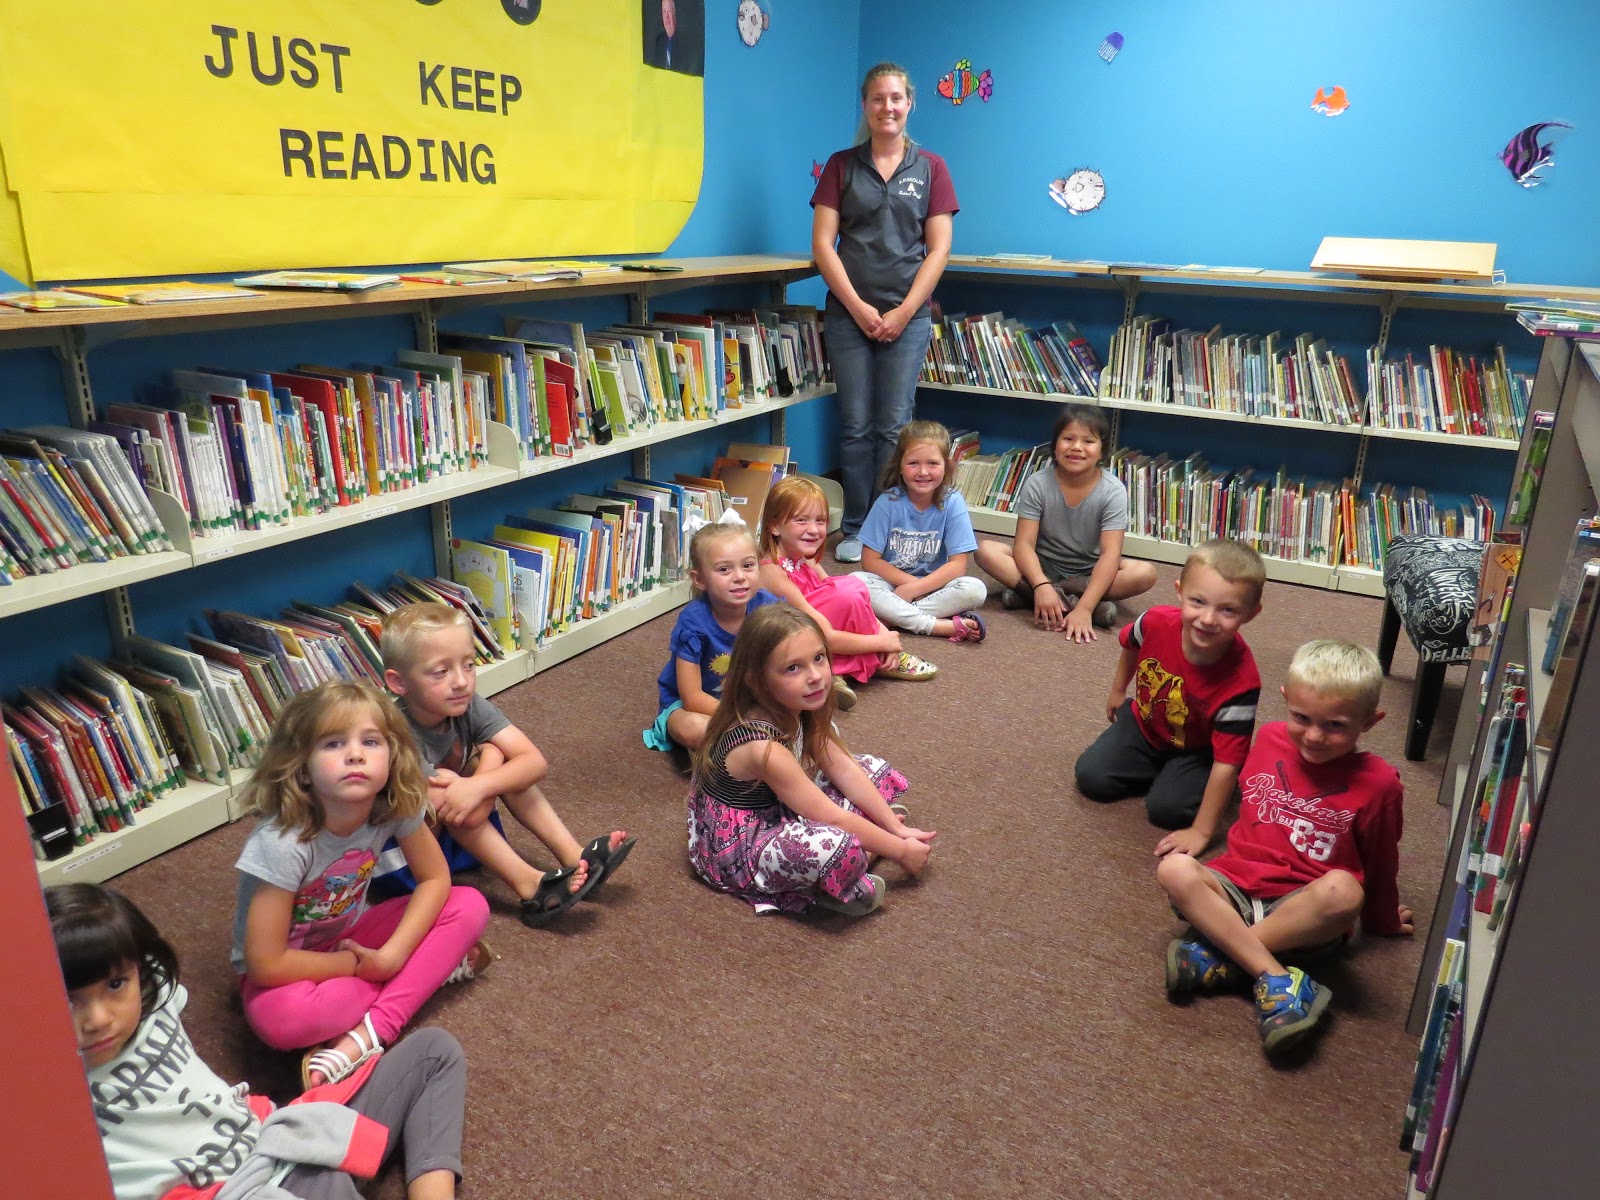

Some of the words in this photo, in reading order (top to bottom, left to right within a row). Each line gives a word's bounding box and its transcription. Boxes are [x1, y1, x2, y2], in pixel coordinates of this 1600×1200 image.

[204, 24, 351, 94] JUST
[419, 61, 523, 116] KEEP
[279, 128, 497, 185] READING
[898, 177, 924, 186] ARMOUR
[889, 533, 942, 556] NIGHTHAW
[1243, 773, 1355, 824] Baseball
[1290, 818, 1336, 861] 83
